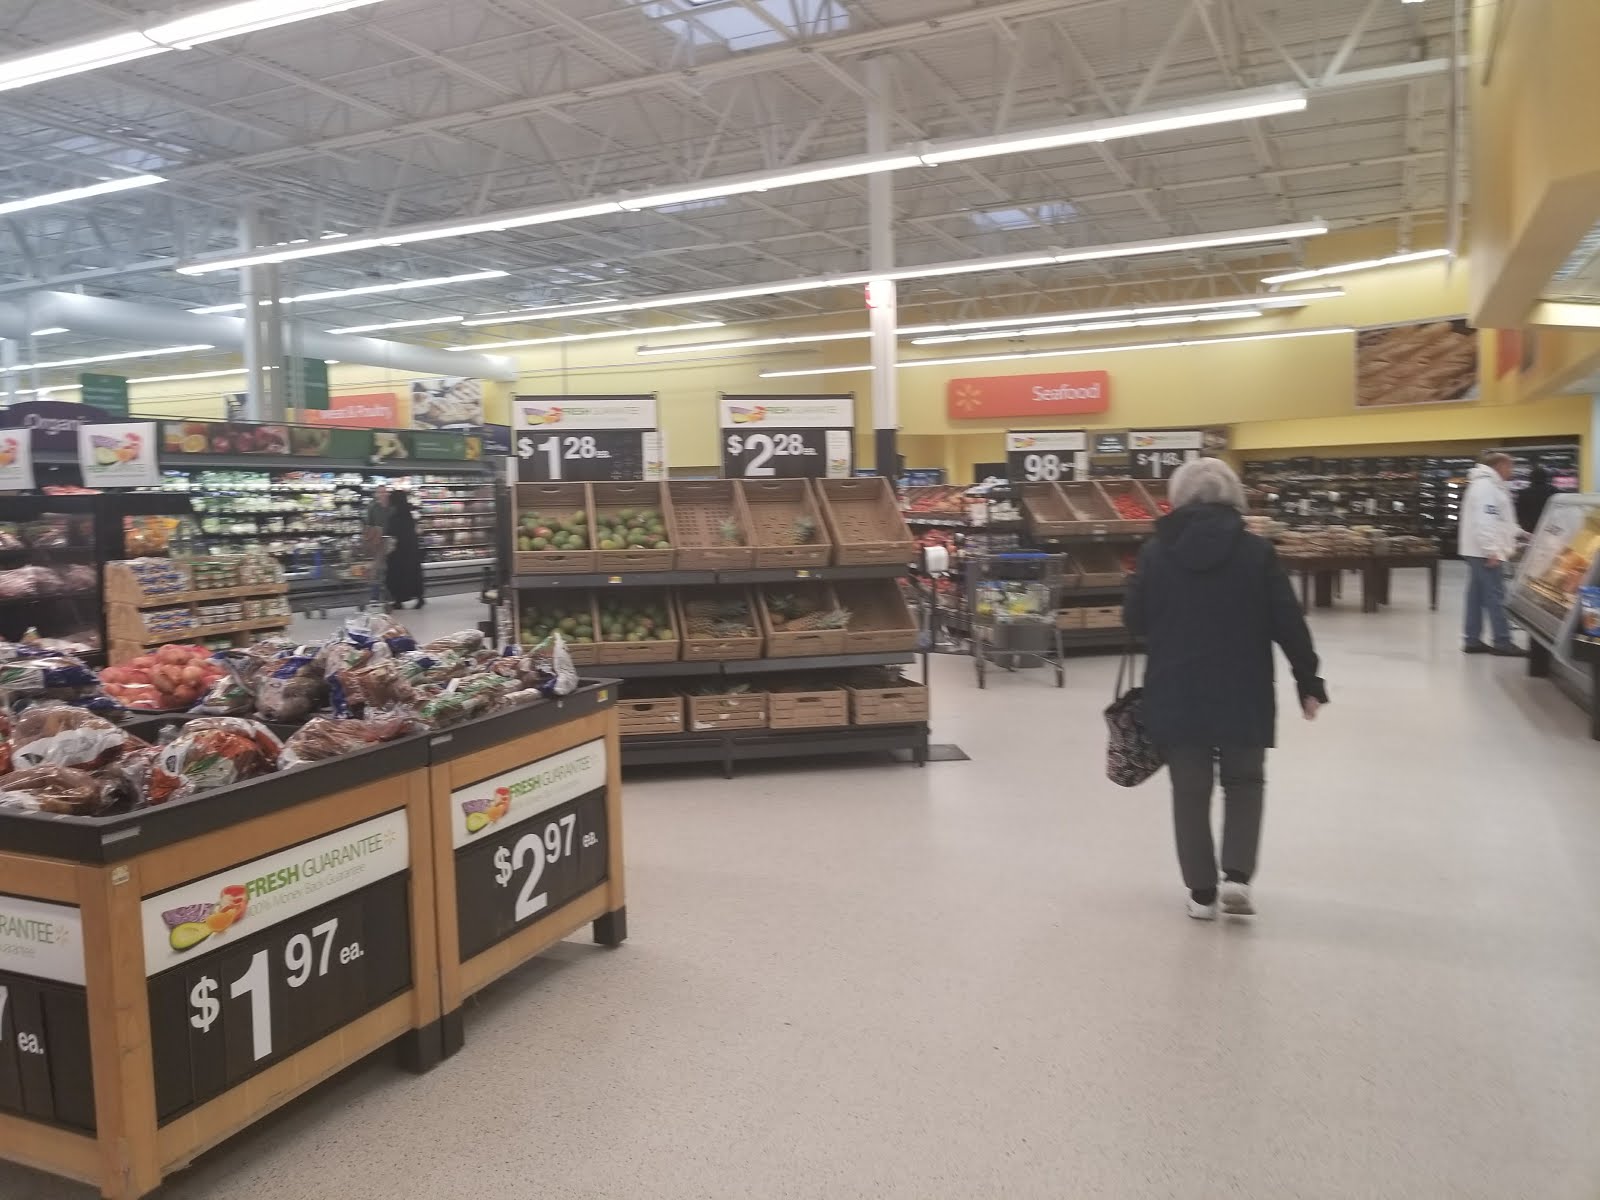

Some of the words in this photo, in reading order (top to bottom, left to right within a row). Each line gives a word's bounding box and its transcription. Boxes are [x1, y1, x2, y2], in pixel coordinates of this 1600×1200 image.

[1031, 382, 1101, 401] Seafood
[510, 774, 541, 797] FRESH
[245, 863, 300, 901] FRESH
[301, 832, 384, 879] GUARANTEE
[340, 942, 364, 964] ea.
[18, 1031, 45, 1055] ea.
